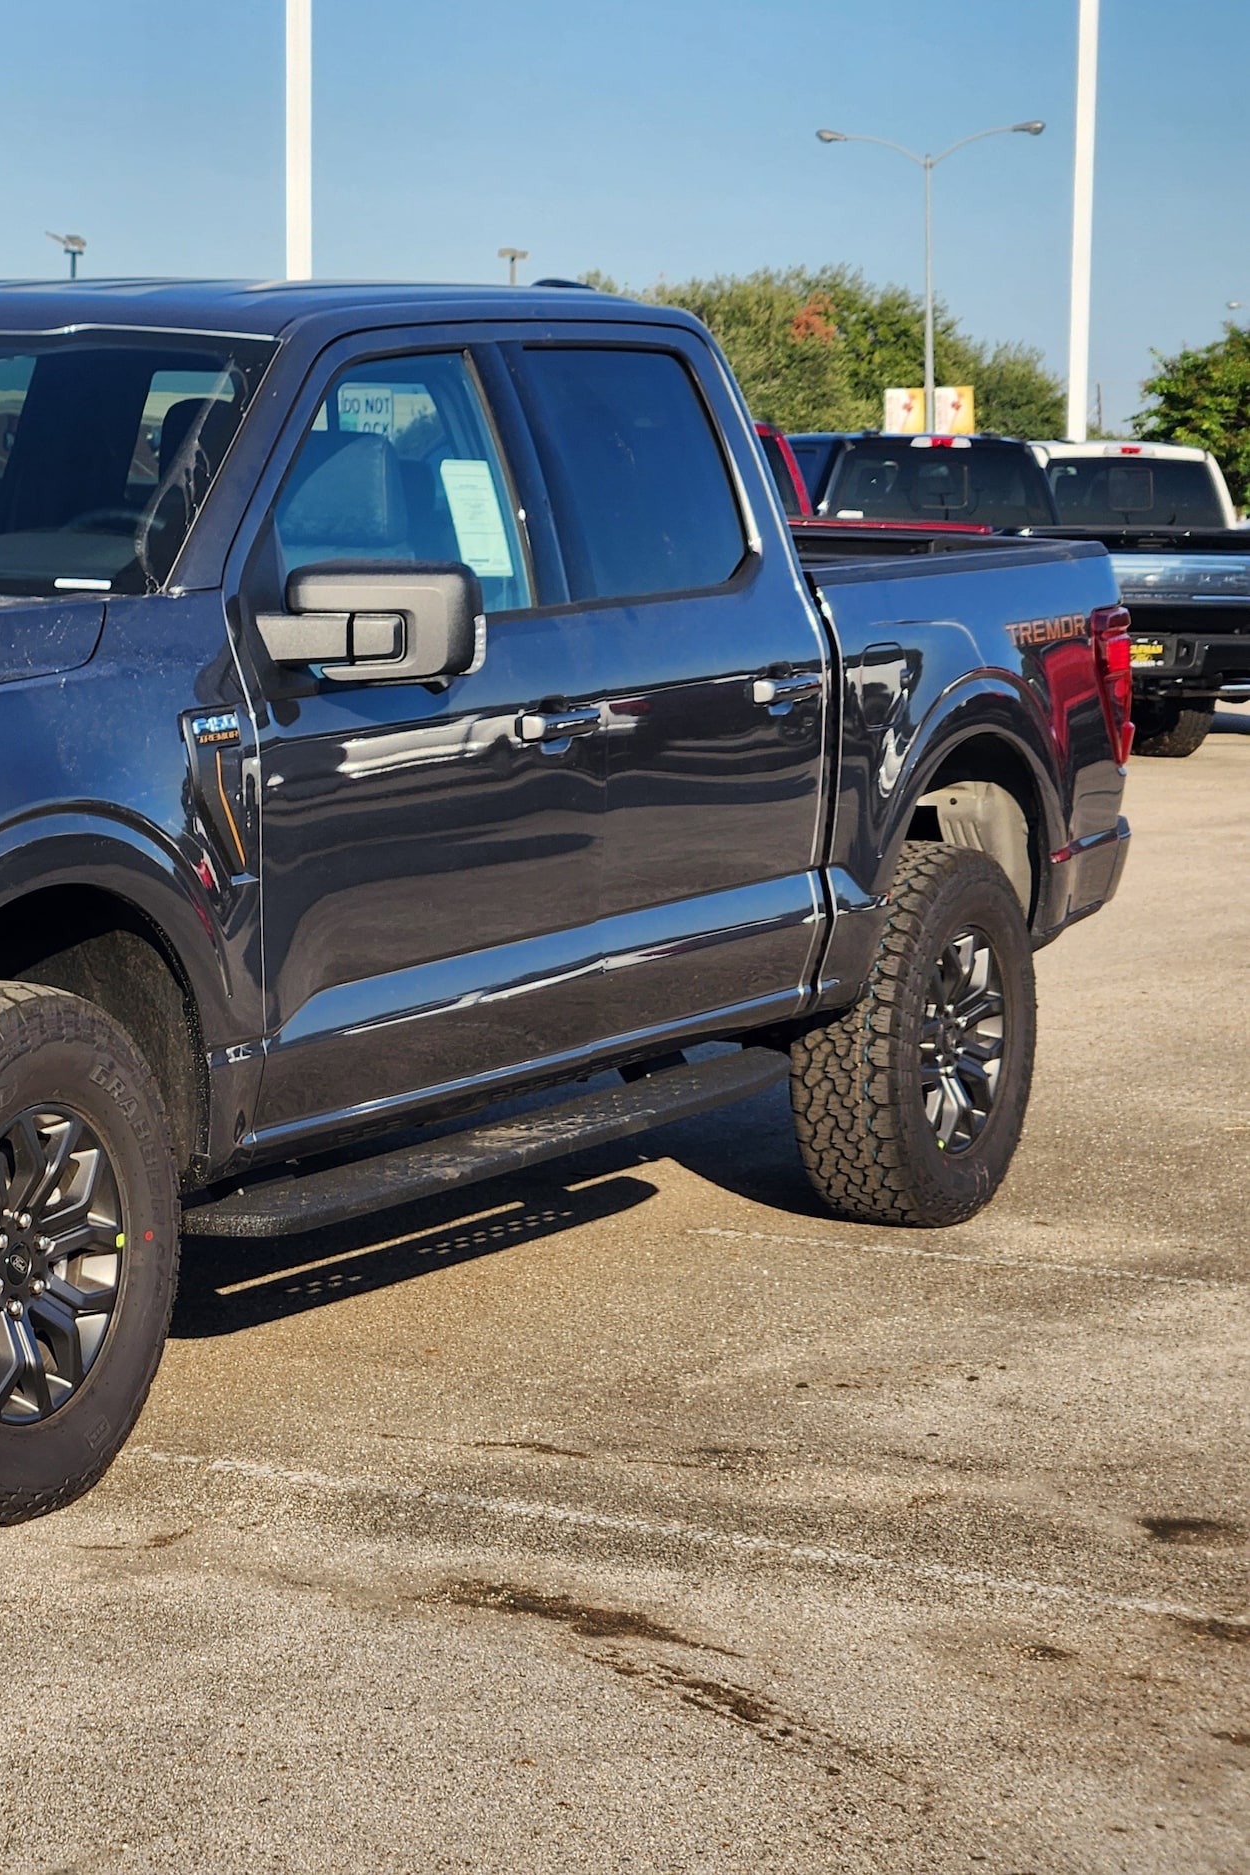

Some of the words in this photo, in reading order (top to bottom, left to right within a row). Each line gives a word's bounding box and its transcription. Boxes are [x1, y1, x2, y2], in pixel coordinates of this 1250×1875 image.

[343, 397, 361, 414] DO
[365, 397, 390, 414] NOT
[363, 421, 390, 434] OCK
[1005, 614, 1086, 646] TREMOR
[196, 730, 239, 744] TREMOR
